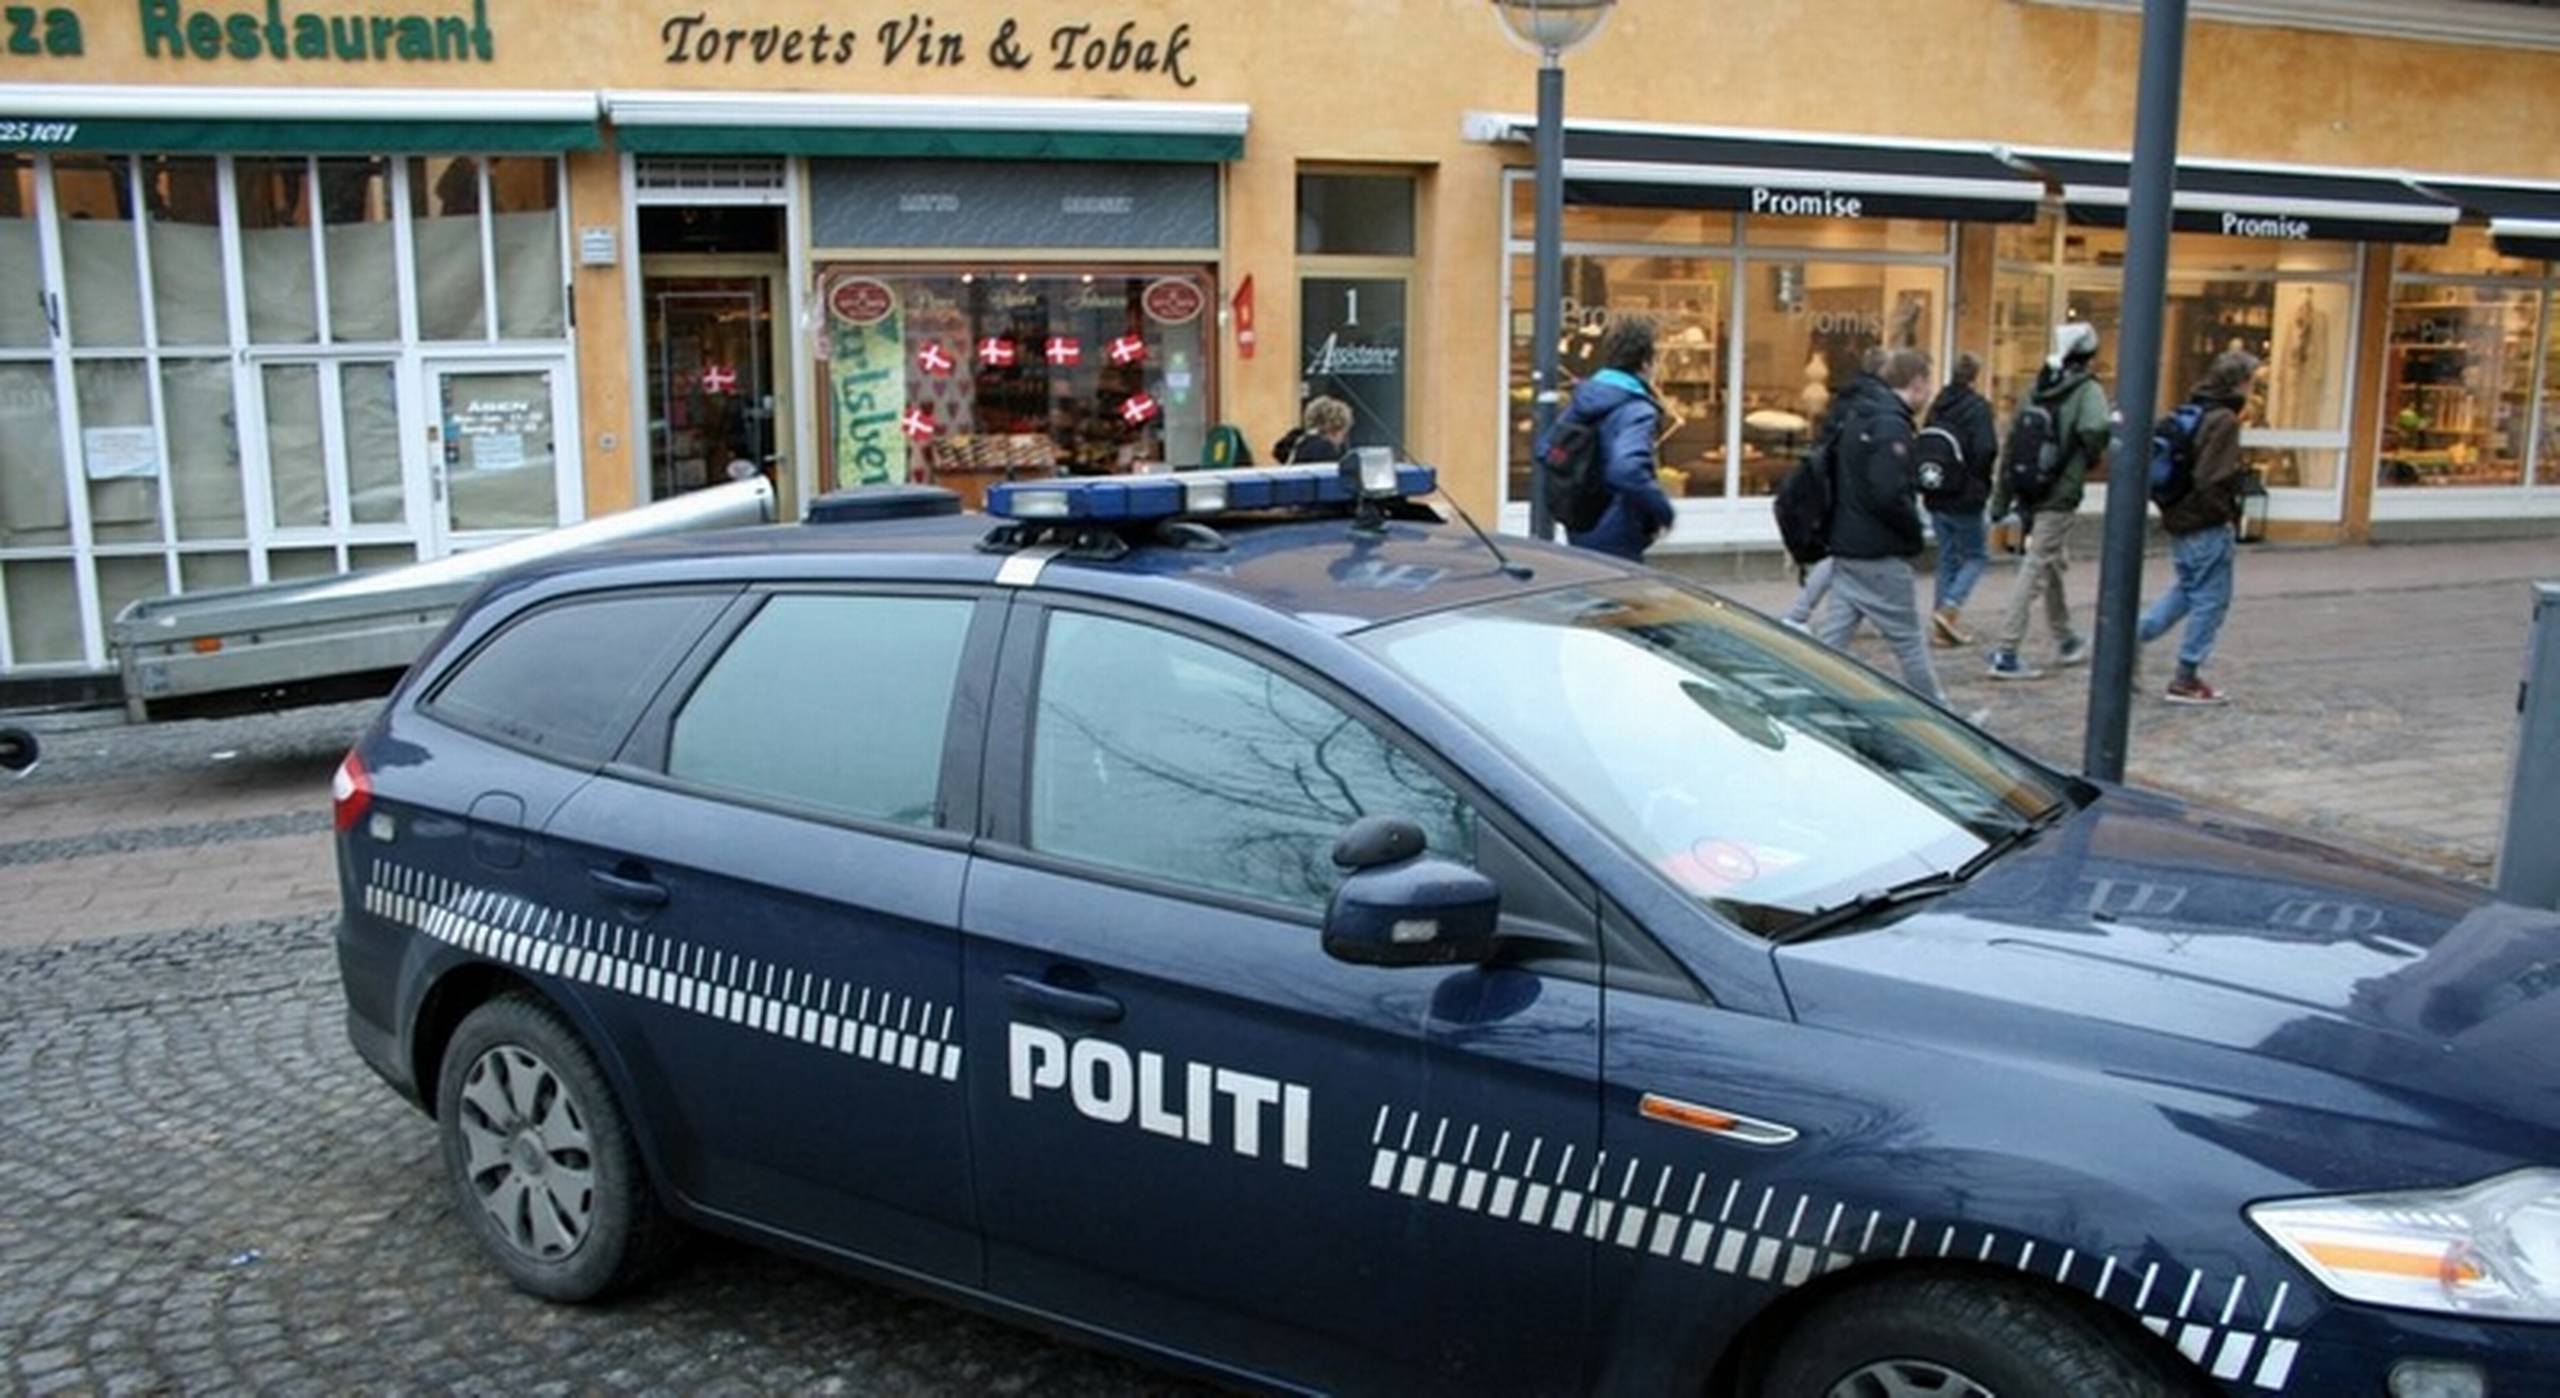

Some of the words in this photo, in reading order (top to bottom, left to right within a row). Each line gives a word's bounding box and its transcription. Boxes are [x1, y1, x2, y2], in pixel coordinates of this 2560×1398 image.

[0, 7, 84, 57] za
[139, 0, 495, 62] Restaurant
[660, 13, 858, 64] Torvets
[877, 14, 967, 66] Vin
[988, 18, 1032, 70] &
[1050, 21, 1198, 88] Tobak
[1752, 187, 1862, 218] Promise
[2222, 211, 2310, 240] Promise
[1345, 288, 1358, 326] 1
[1009, 1021, 1310, 1170] POLITI
